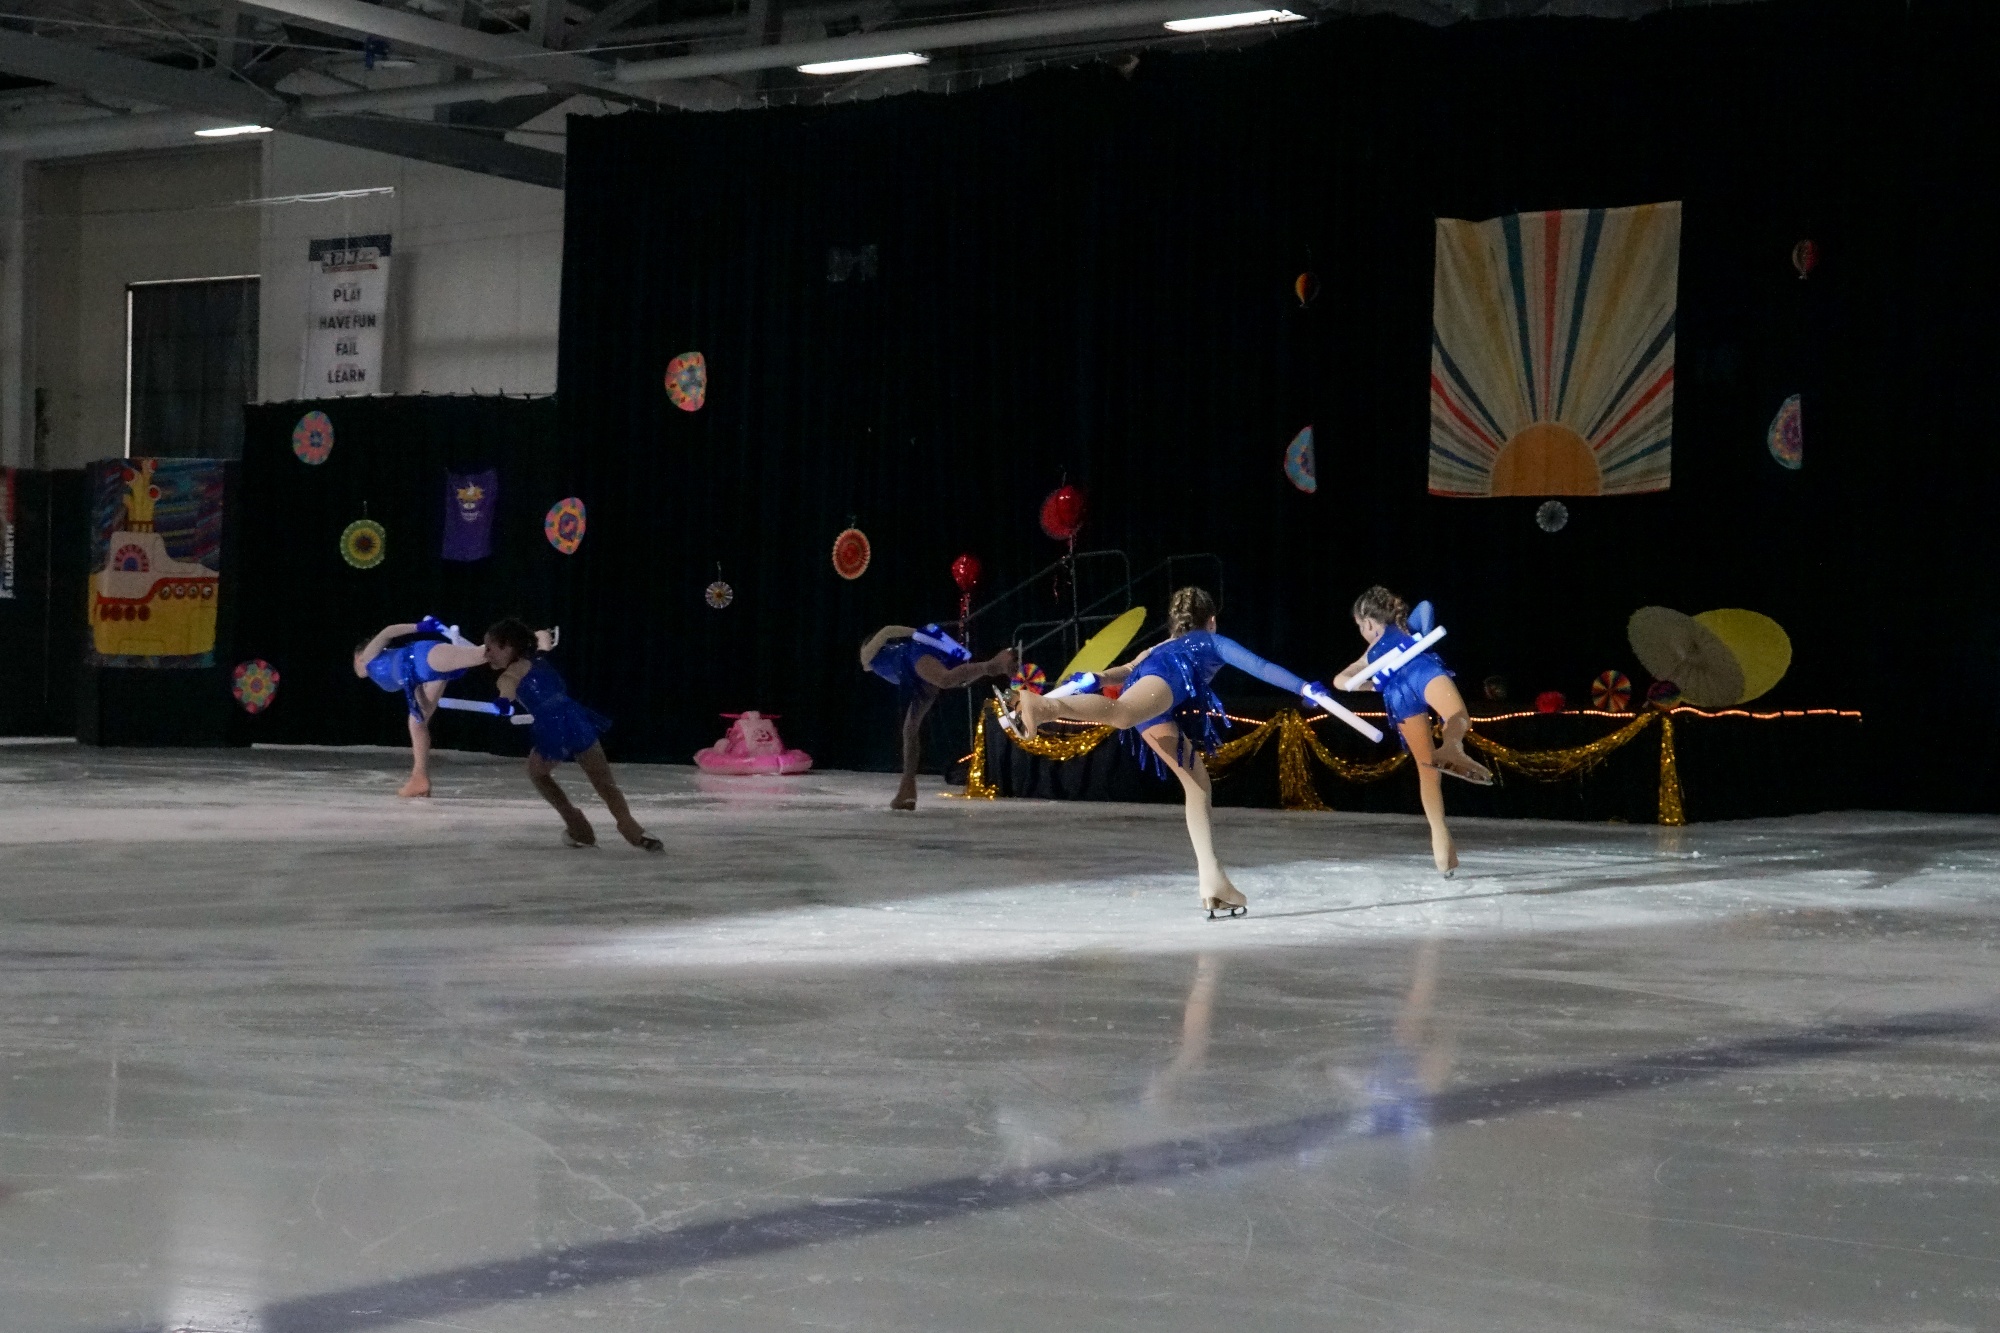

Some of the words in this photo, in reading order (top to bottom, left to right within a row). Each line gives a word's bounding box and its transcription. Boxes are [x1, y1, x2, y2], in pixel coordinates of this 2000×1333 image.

[319, 316, 350, 329] HAVE
[353, 314, 376, 328] FUN
[336, 342, 359, 356] FAIL
[327, 369, 366, 384] LEARN
